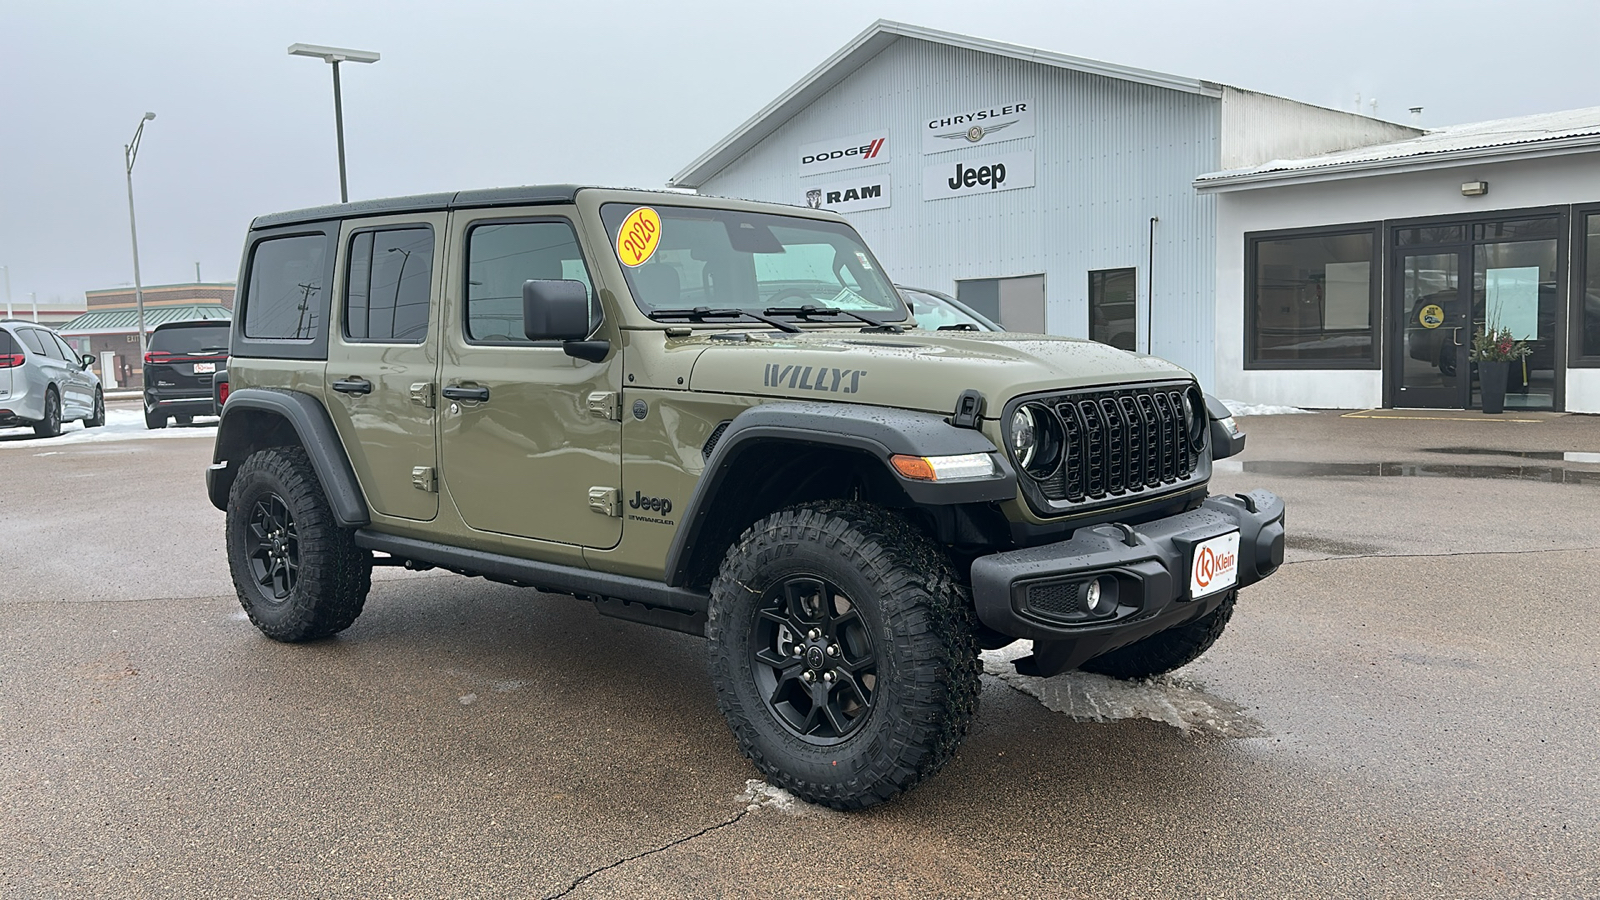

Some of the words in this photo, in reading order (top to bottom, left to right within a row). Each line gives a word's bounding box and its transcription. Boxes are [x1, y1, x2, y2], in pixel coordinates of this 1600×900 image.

[928, 103, 1027, 129] CHRYSLER
[802, 144, 873, 164] DODGE
[948, 163, 1006, 190] Jeep
[827, 184, 881, 204] RAM
[623, 211, 656, 262] 2026
[764, 363, 868, 394] WILLYS
[629, 490, 672, 517] Jeep
[634, 515, 674, 526] WRANGLER
[1215, 551, 1235, 572] Klein
